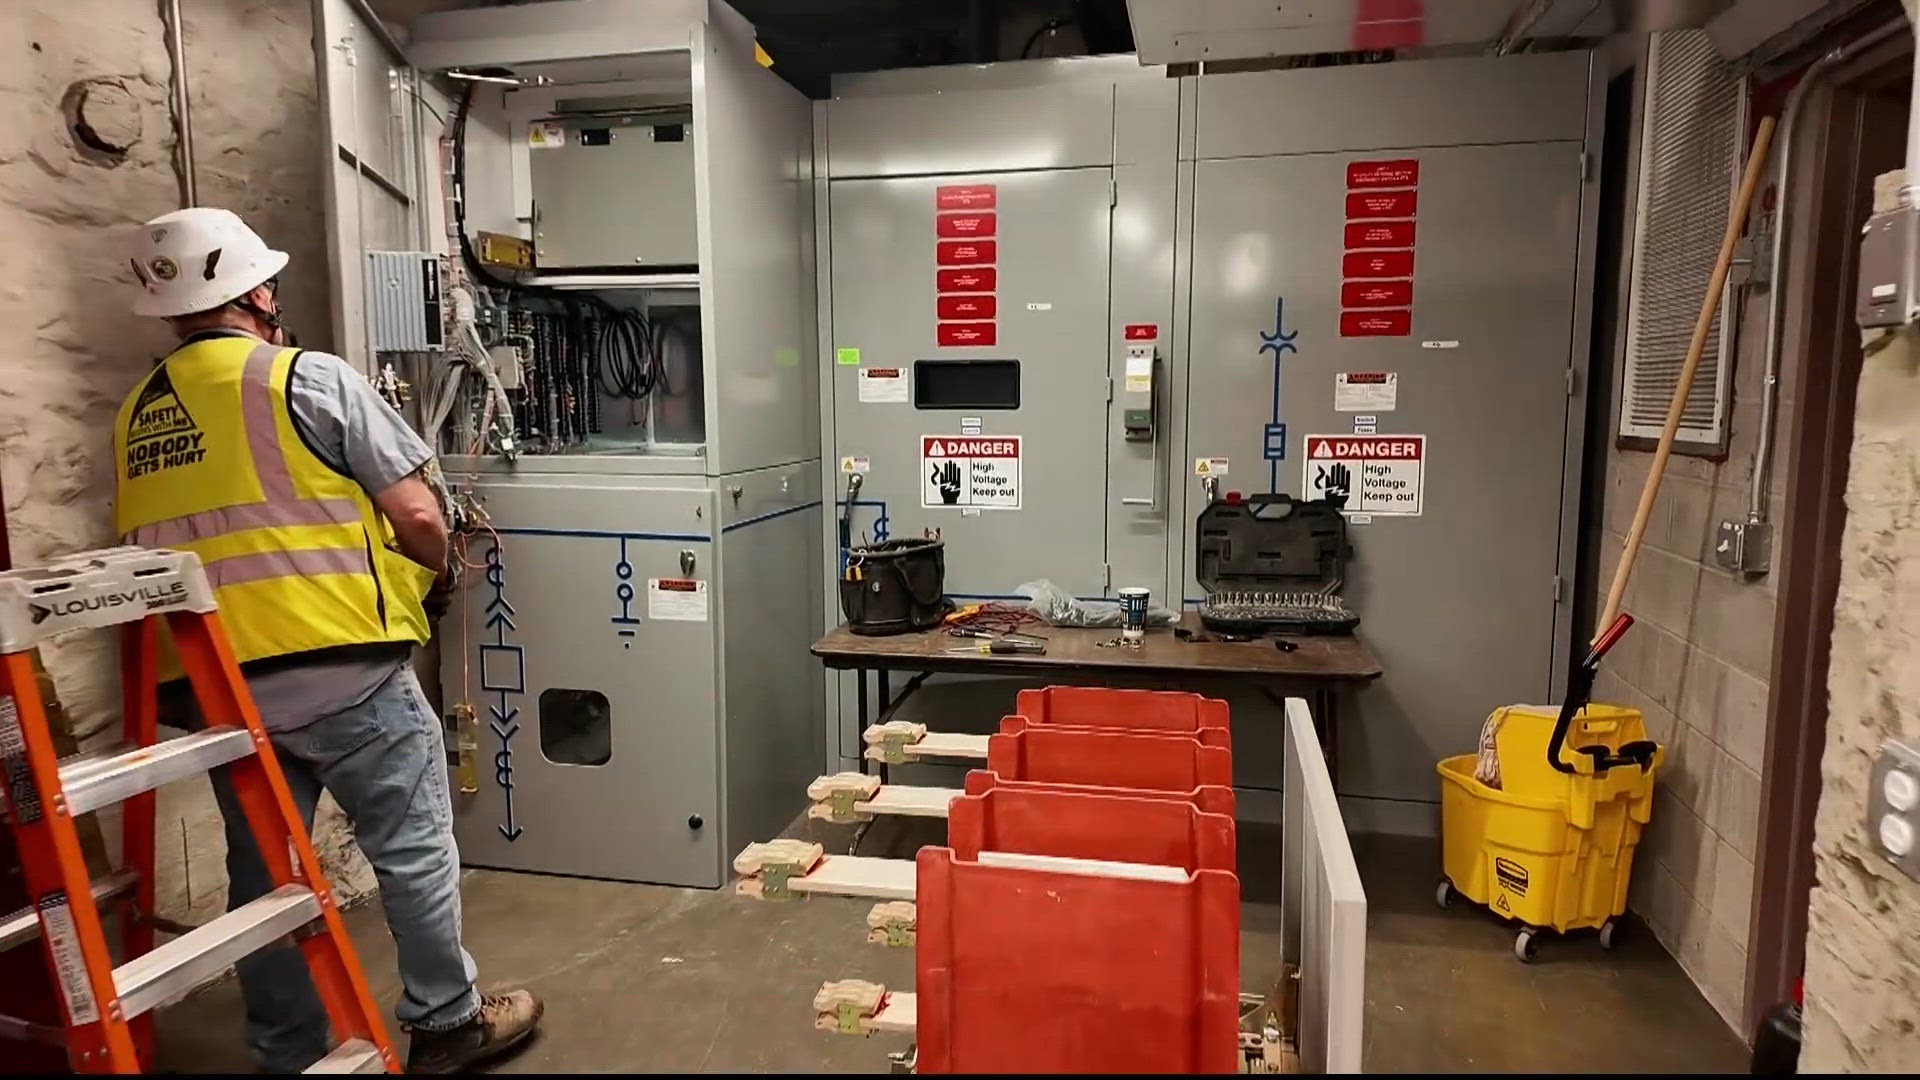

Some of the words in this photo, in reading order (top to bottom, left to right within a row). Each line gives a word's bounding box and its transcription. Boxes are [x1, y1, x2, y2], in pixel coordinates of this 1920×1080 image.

[139, 405, 178, 427] SAFETY
[127, 432, 203, 467] NOBODY
[947, 442, 1014, 455] DANGER
[1336, 442, 1416, 457] DANGER
[128, 459, 159, 480] GETS
[163, 449, 206, 469] HURT
[973, 462, 995, 473] High
[1365, 465, 1391, 476] High
[973, 475, 1008, 486] Voltage
[1364, 478, 1406, 489] Voltage
[973, 488, 997, 498] Keep
[999, 488, 1015, 496] out
[1364, 491, 1393, 502] Keep
[1396, 492, 1414, 501] out
[51, 582, 185, 616] LOUISVILLE
